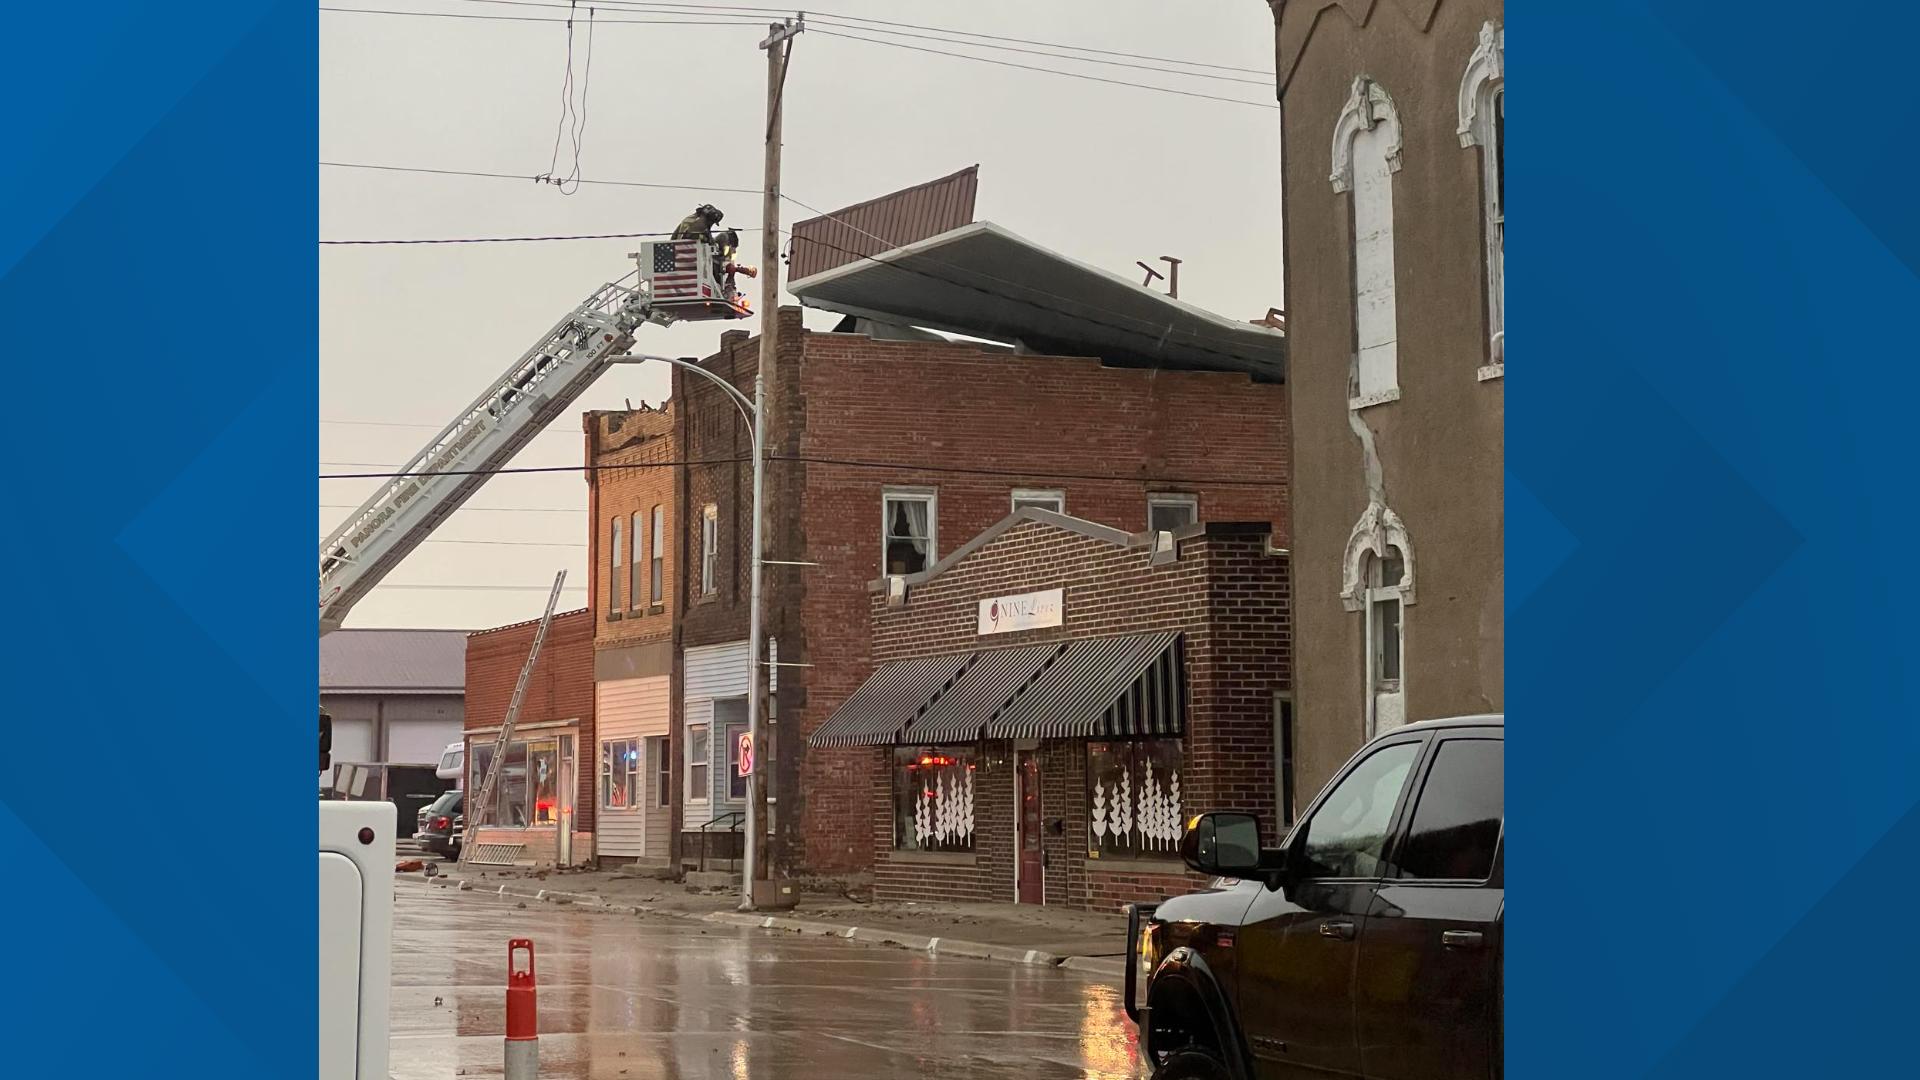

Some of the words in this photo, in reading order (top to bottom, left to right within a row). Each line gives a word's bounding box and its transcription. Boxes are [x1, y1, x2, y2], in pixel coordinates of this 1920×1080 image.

[350, 506, 396, 548] PANORA
[393, 482, 420, 508] FIRE
[1000, 600, 1028, 618] NINE
